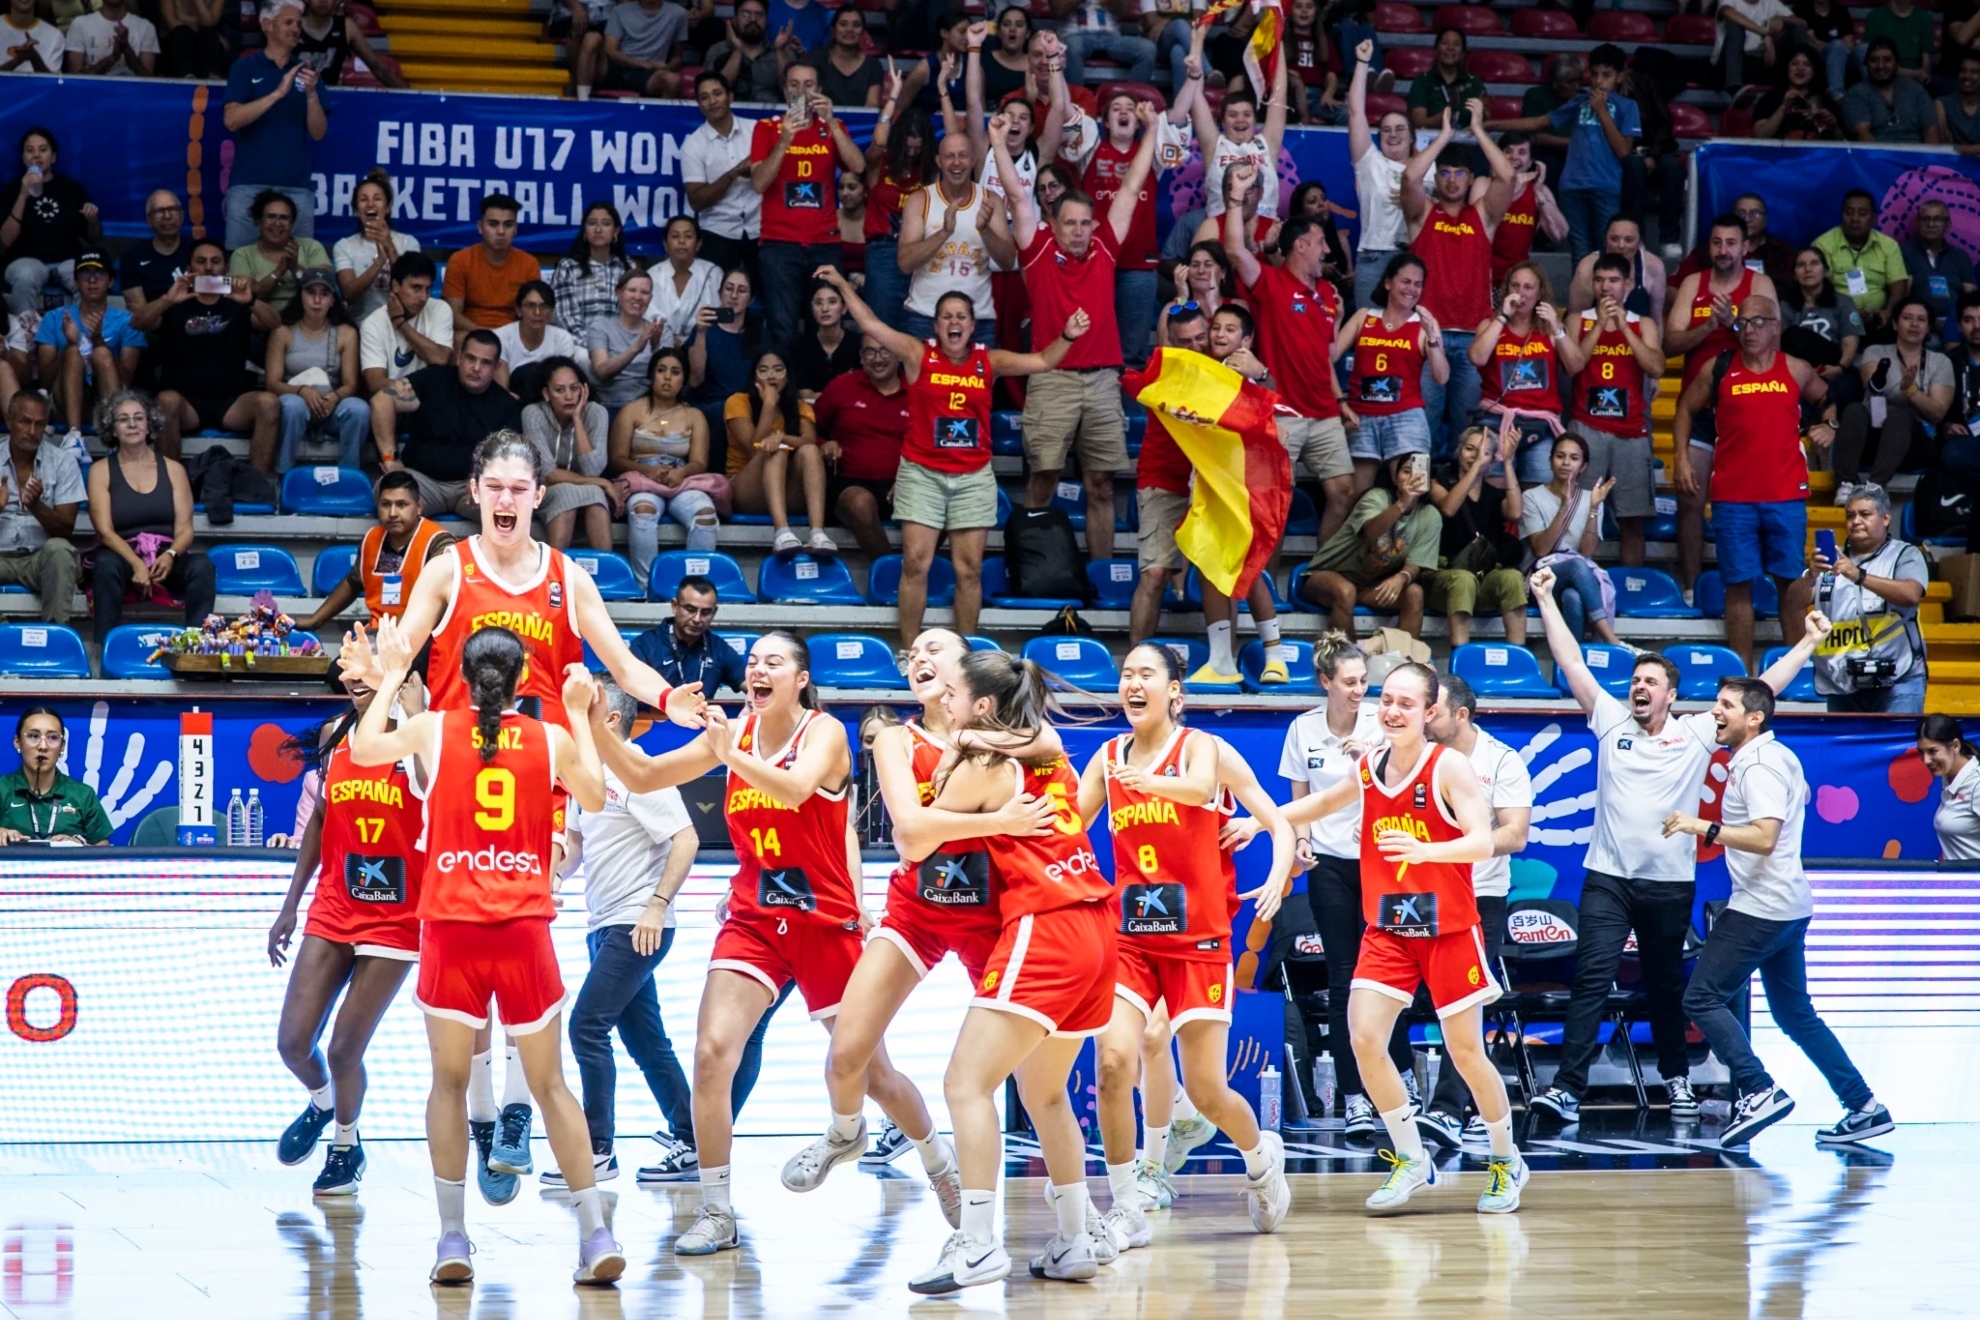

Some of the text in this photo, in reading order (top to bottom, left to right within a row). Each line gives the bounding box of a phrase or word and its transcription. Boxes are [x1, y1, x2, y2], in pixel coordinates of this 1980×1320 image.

[376, 121, 475, 167] FIBA
[494, 126, 576, 171] U17
[797, 160, 812, 177] 10
[310, 172, 584, 227] BAKETALL
[1095, 190, 1148, 201] ena
[1503, 212, 1534, 226] PAÑA
[1358, 337, 1411, 350] ESPAÑA
[1496, 341, 1549, 356] ESPAÑA
[1592, 344, 1634, 356] SPAÑA
[1375, 353, 1388, 372] 6
[1601, 362, 1614, 380] 8
[930, 373, 986, 389] ESPAÑA
[1732, 381, 1788, 395] ESPAÑA
[949, 392, 966, 410] 12
[472, 611, 553, 646] ESPAÑA
[471, 726, 523, 750] SNZ
[193, 739, 203, 755] 4
[194, 761, 204, 777] 3
[194, 784, 204, 799] 2
[331, 778, 404, 809] ESPAÑA
[475, 767, 516, 831] 9
[728, 788, 799, 815] ESPA
[194, 806, 202, 822] 1
[355, 817, 385, 843] 17
[750, 827, 781, 857] 14
[437, 844, 542, 875] endesa
[1045, 847, 1099, 882] ede
[1138, 844, 1159, 874] 8
[351, 887, 397, 901] CaixaBank
[924, 888, 979, 904] CaixaBank
[1128, 920, 1178, 932] CaixaBank
[1511, 915, 1552, 927] 百岁山
[1385, 928, 1431, 938] CxaBank
